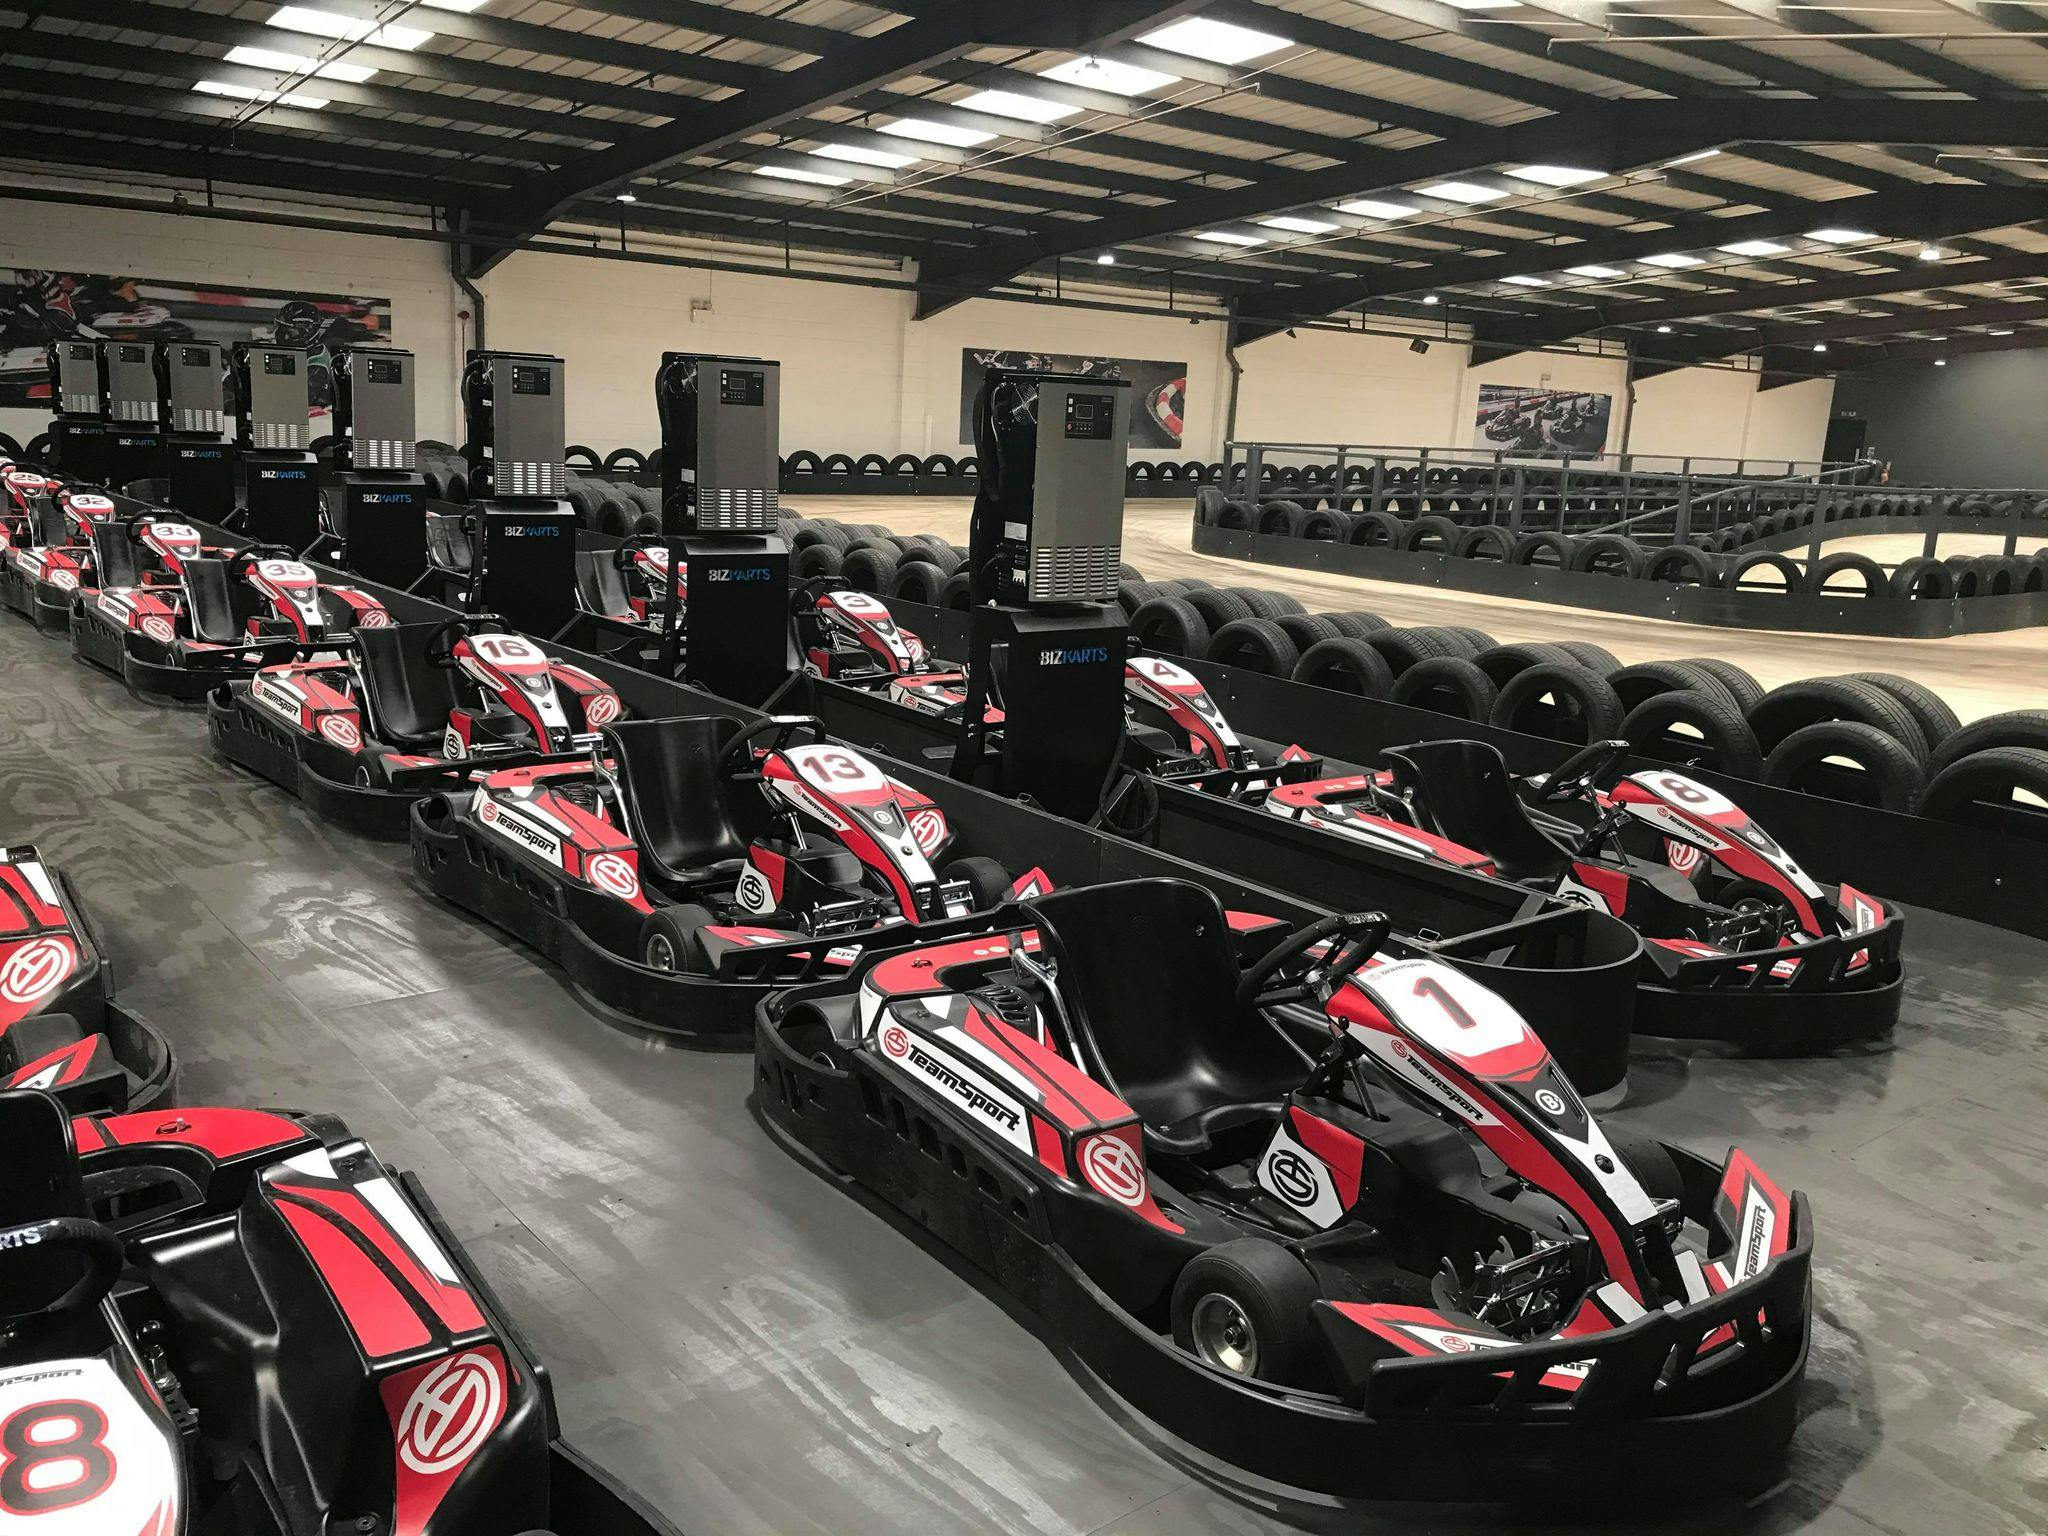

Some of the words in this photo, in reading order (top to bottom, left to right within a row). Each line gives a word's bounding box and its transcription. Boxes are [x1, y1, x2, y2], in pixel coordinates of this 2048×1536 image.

[261, 470, 306, 479] BIZKARTS
[363, 493, 412, 503] BIZKARTS
[505, 526, 560, 537] BIZKARTS
[266, 563, 307, 577] 35
[708, 568, 772, 582] BIZKARTS
[481, 640, 530, 659] 16
[1040, 647, 1109, 666] BIZKARTS
[1153, 662, 1179, 678] 4
[262, 687, 299, 716] TeamSport
[802, 754, 866, 783] 13
[1660, 778, 1710, 804] 8
[496, 812, 557, 855] TeamSport
[1412, 976, 1477, 1030] 1
[907, 1043, 1020, 1131] TeamSport
[1406, 1054, 1484, 1121] TeamSport
